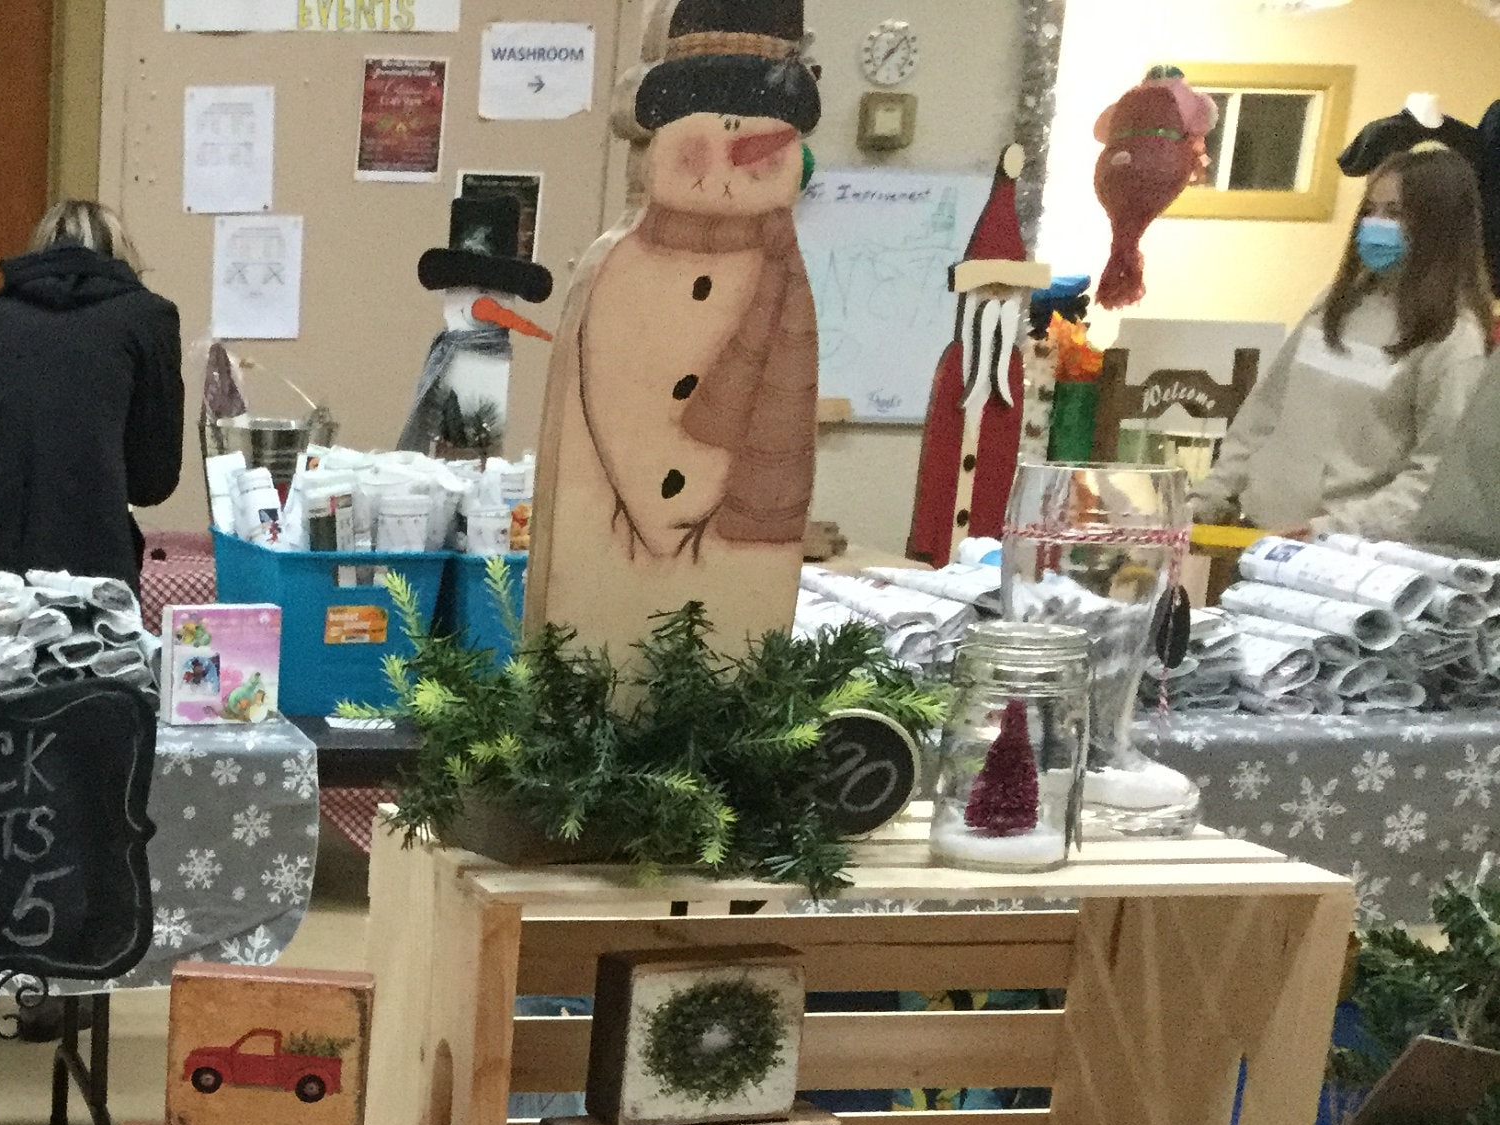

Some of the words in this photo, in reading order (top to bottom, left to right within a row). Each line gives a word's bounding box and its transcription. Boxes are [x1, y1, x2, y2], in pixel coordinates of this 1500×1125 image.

[297, 0, 415, 30] EVENTS
[491, 46, 585, 62] WASHROOM
[1141, 381, 1216, 413] Welcome
